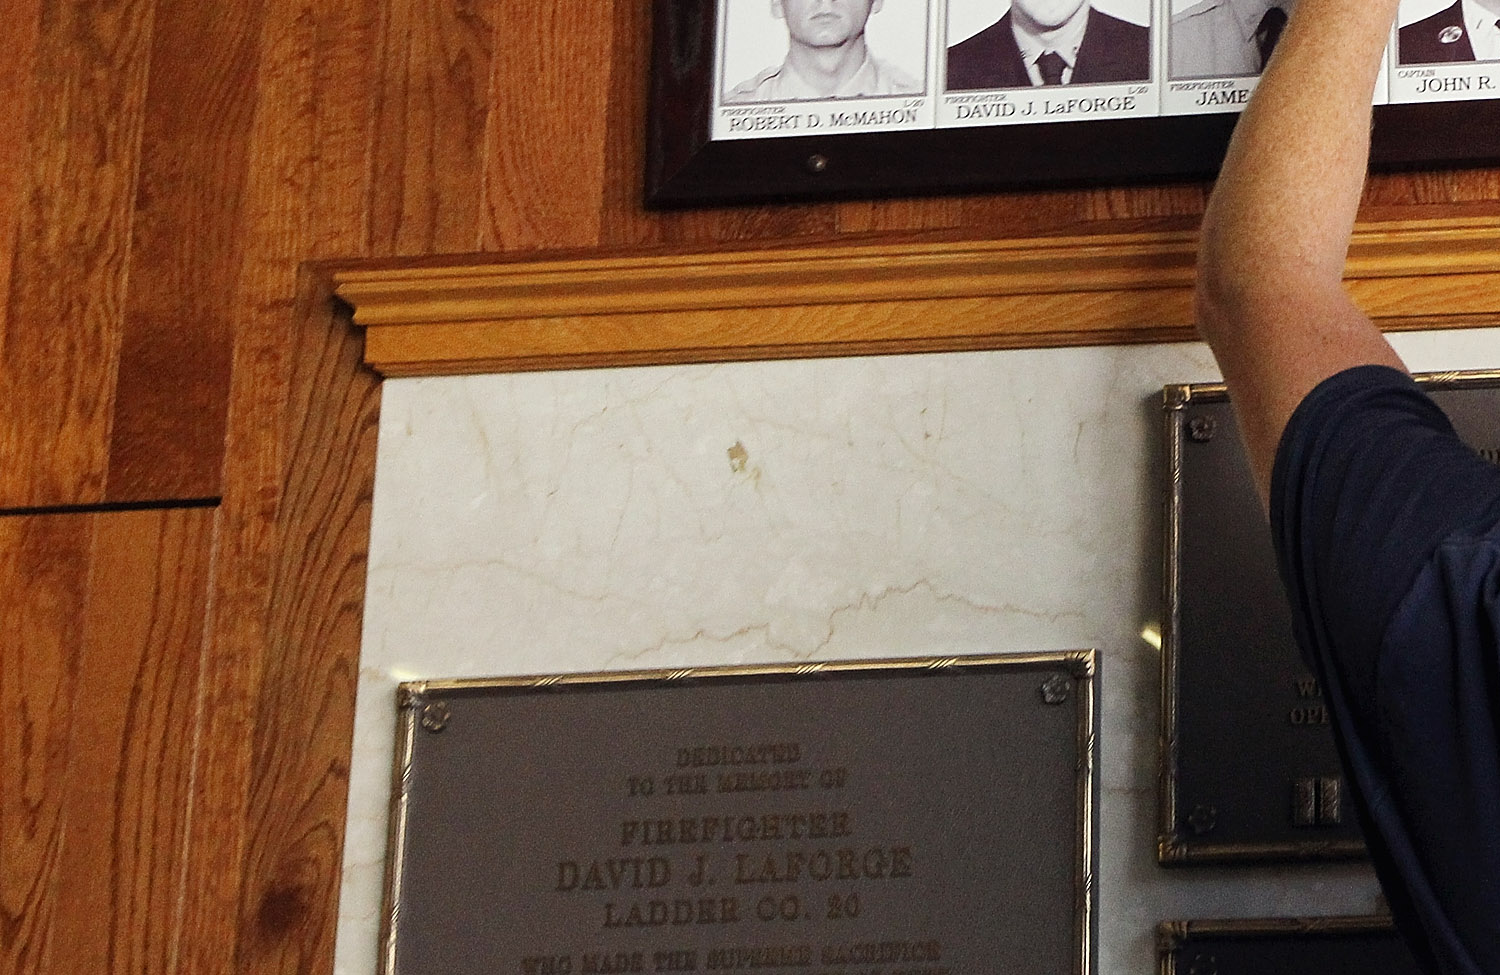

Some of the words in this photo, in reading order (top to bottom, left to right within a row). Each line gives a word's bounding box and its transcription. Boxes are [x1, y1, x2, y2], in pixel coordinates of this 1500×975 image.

[1398, 69, 1436, 78] CAPTAIN
[1416, 76, 1471, 93] JOHN
[1478, 76, 1495, 90] R.
[1169, 81, 1234, 91] FIREFIGHTER
[1196, 89, 1249, 105] JAME
[957, 102, 1016, 120] DAVID
[1022, 101, 1038, 116] J.
[1044, 96, 1136, 115] LaFORGE
[730, 114, 801, 132] ROBERT
[807, 114, 824, 128] D.
[830, 109, 917, 127] McMAHON
[675, 742, 801, 767] DEDICATED
[627, 776, 654, 797] TO
[663, 774, 708, 795] THE
[718, 770, 811, 793] MEMORY
[819, 767, 848, 789] OF
[621, 812, 851, 846] FIREFIGHTER
[555, 855, 672, 893] DAVID
[689, 853, 715, 887] J.
[735, 846, 912, 885] LAFORGE
[602, 897, 740, 929] LADDER
[756, 894, 811, 922] CO.
[826, 892, 860, 920] 20
